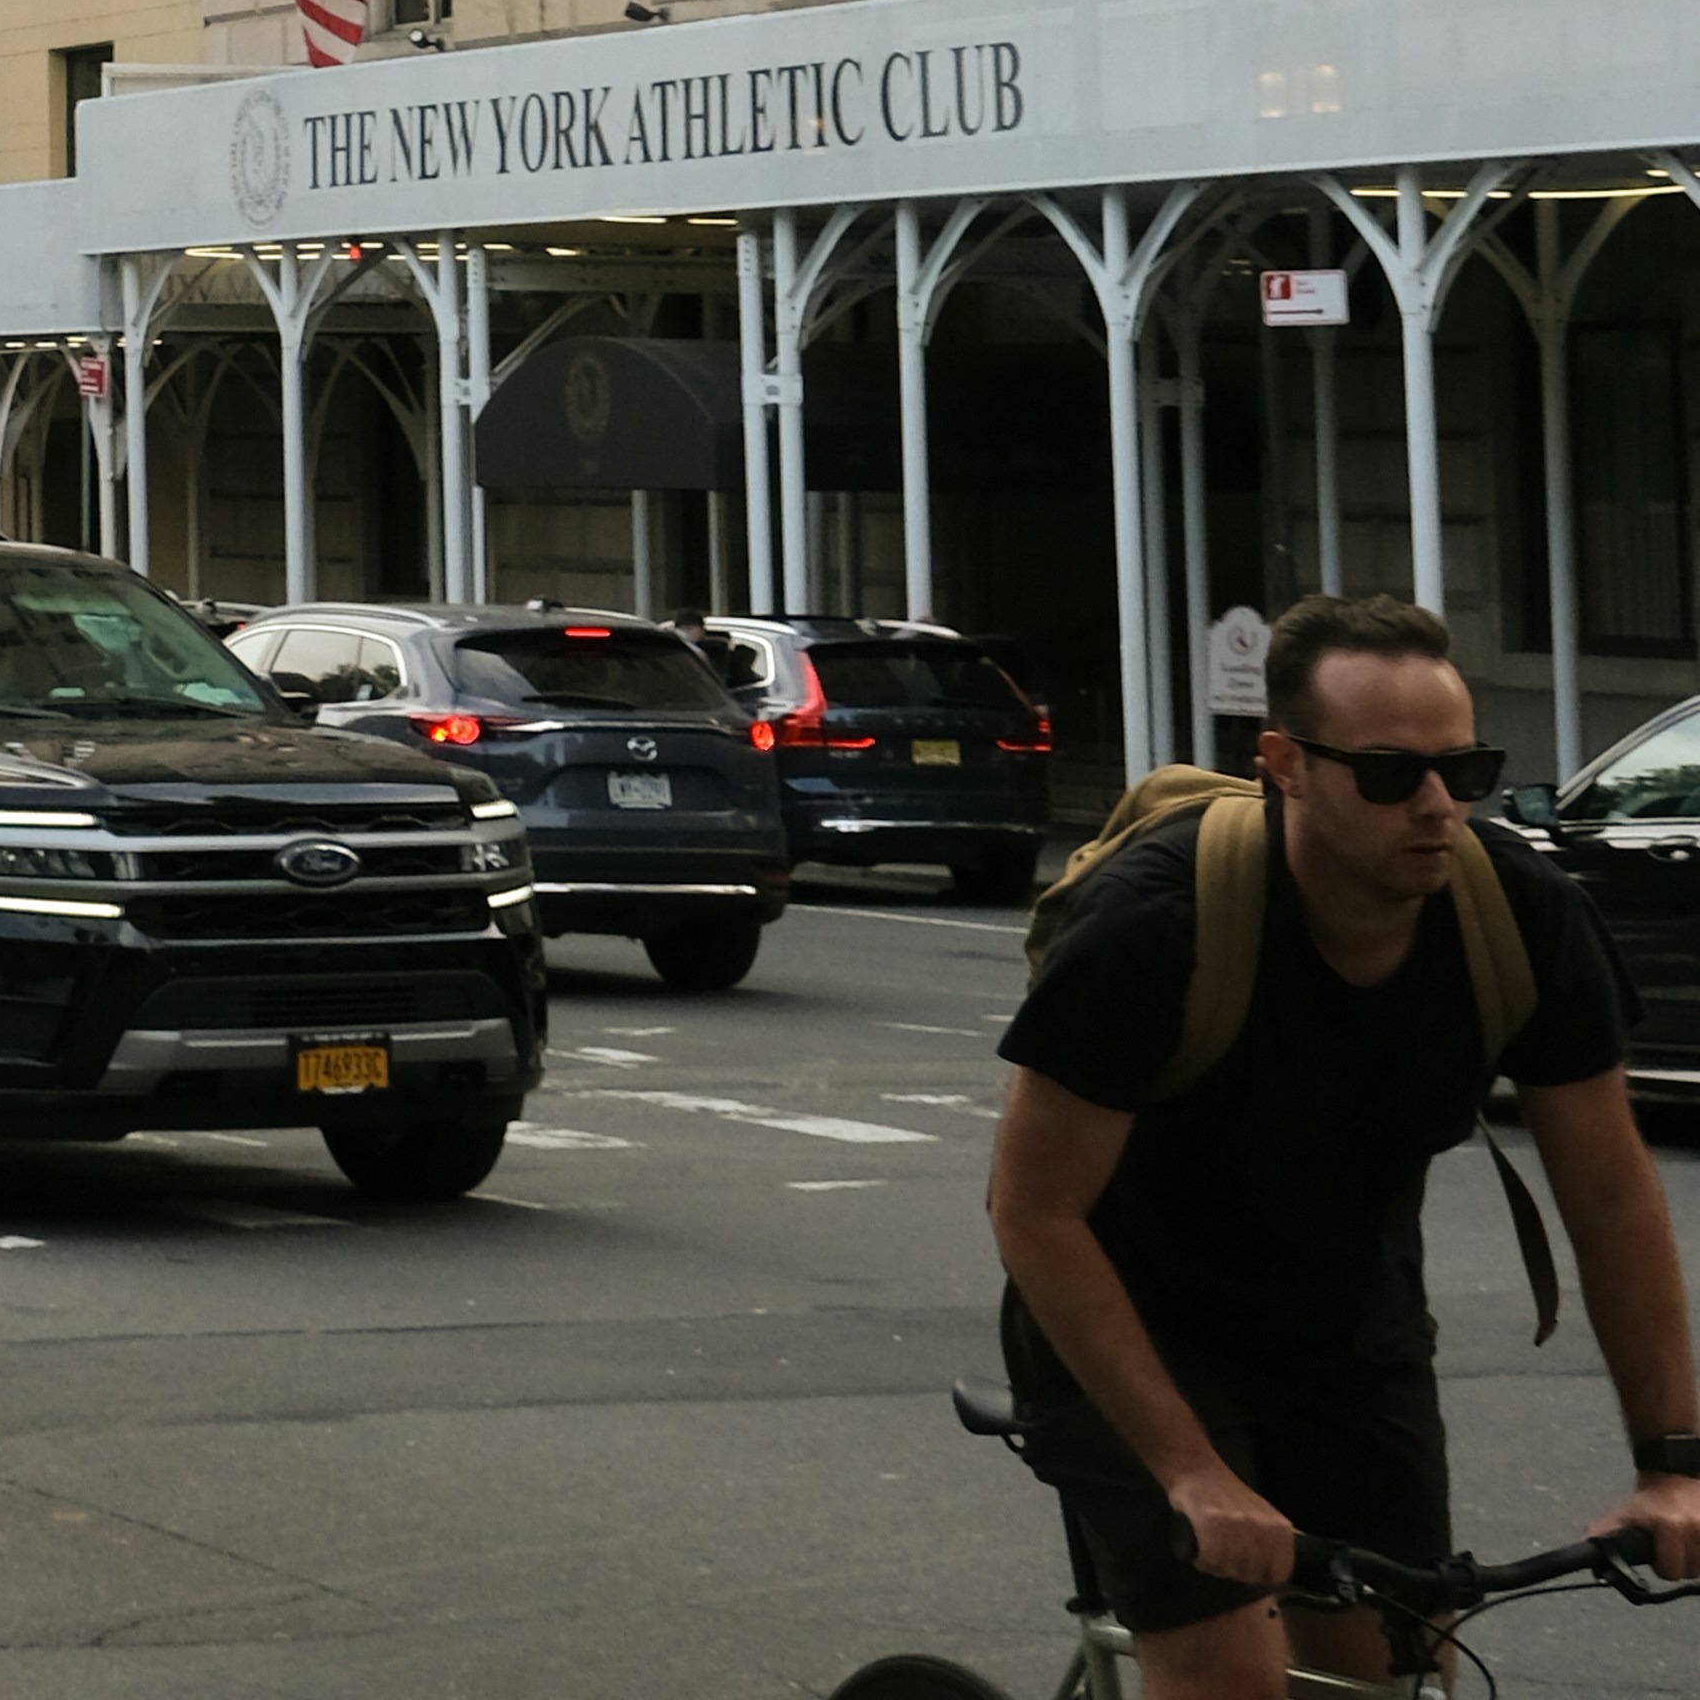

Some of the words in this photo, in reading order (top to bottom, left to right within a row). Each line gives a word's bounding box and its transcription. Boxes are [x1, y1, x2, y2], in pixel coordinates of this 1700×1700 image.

[303, 110, 378, 190] THE
[389, 99, 480, 183] NEW
[490, 86, 614, 175] YORK
[624, 57, 865, 165] ATHLETIC
[880, 41, 1024, 142] CLUB
